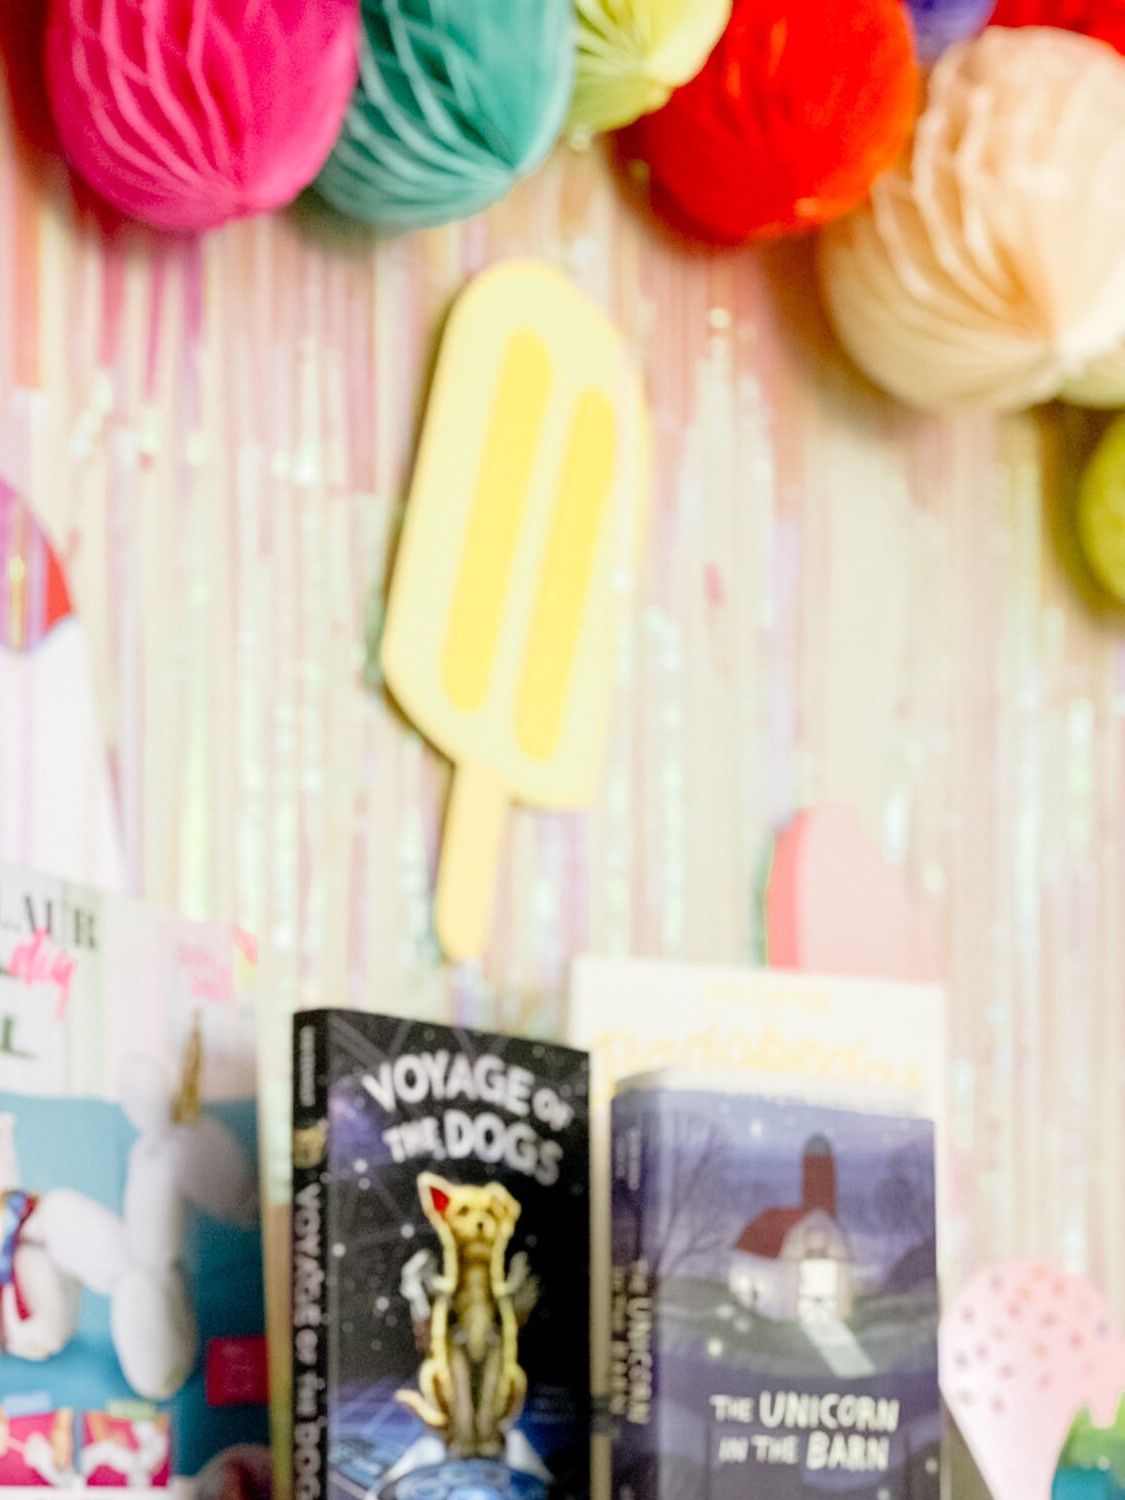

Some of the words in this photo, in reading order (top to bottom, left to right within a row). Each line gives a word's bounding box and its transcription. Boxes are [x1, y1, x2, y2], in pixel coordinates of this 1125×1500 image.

[362, 1049, 535, 1116] VOYAGE
[444, 1110, 563, 1186] DOGS
[709, 1394, 754, 1423] THE
[759, 1390, 900, 1433] UNICORN
[751, 1434, 800, 1465] THE
[806, 1430, 890, 1471] BARN
